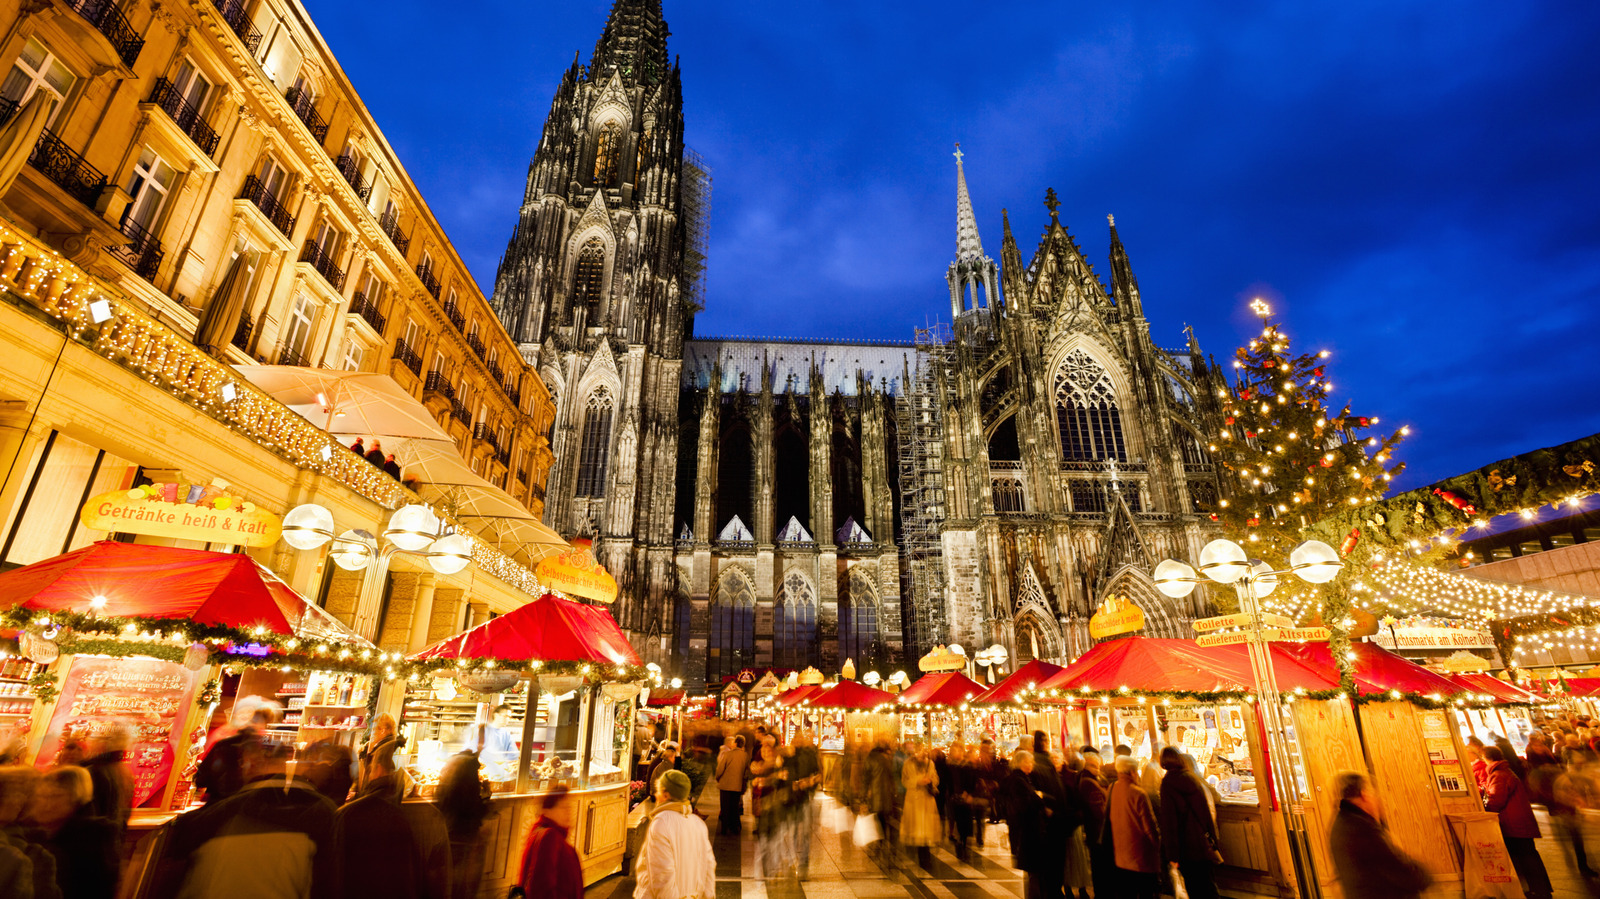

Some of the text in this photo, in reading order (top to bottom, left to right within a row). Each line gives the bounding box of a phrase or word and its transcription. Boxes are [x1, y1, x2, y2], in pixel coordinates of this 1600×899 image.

[98, 502, 267, 535] Getränke heiß & kalt
[541, 565, 614, 594] Selbstgemachte Brezel
[1121, 615, 1125, 625] &
[1126, 613, 1140, 624] mehr
[1196, 618, 1235, 631] Toilette
[1200, 634, 1247, 646] Anlieferung
[1279, 630, 1327, 639] Altstadt
[1437, 635, 1451, 646] am
[1451, 633, 1478, 646] Kölner
